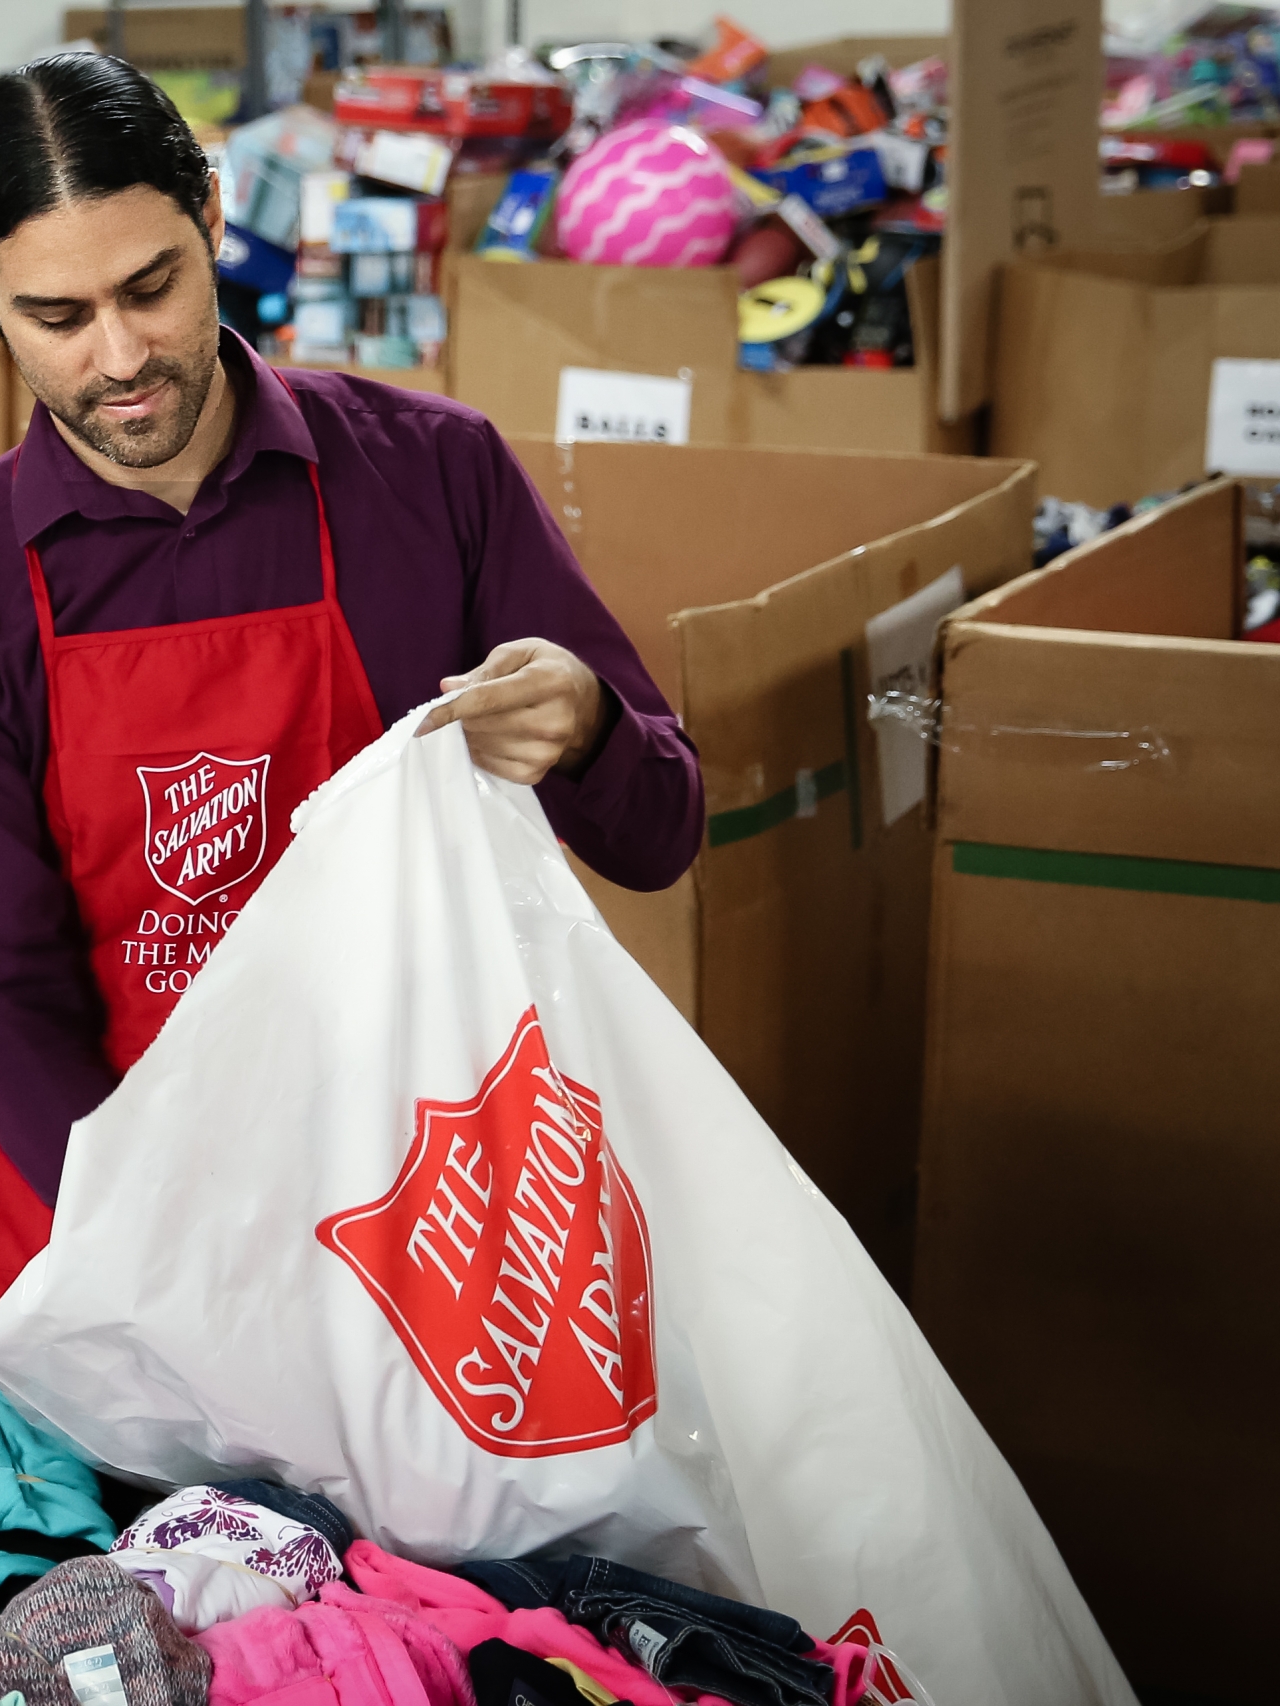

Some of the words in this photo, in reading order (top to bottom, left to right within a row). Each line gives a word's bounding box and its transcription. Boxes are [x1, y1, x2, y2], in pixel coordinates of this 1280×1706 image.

[151, 768, 258, 865] SALVATION
[164, 763, 216, 815] THE
[176, 815, 253, 887] ARMY
[121, 940, 177, 965] THE
[145, 970, 193, 994] GO
[406, 1132, 494, 1301] THE
[454, 1065, 588, 1432] SALVATION
